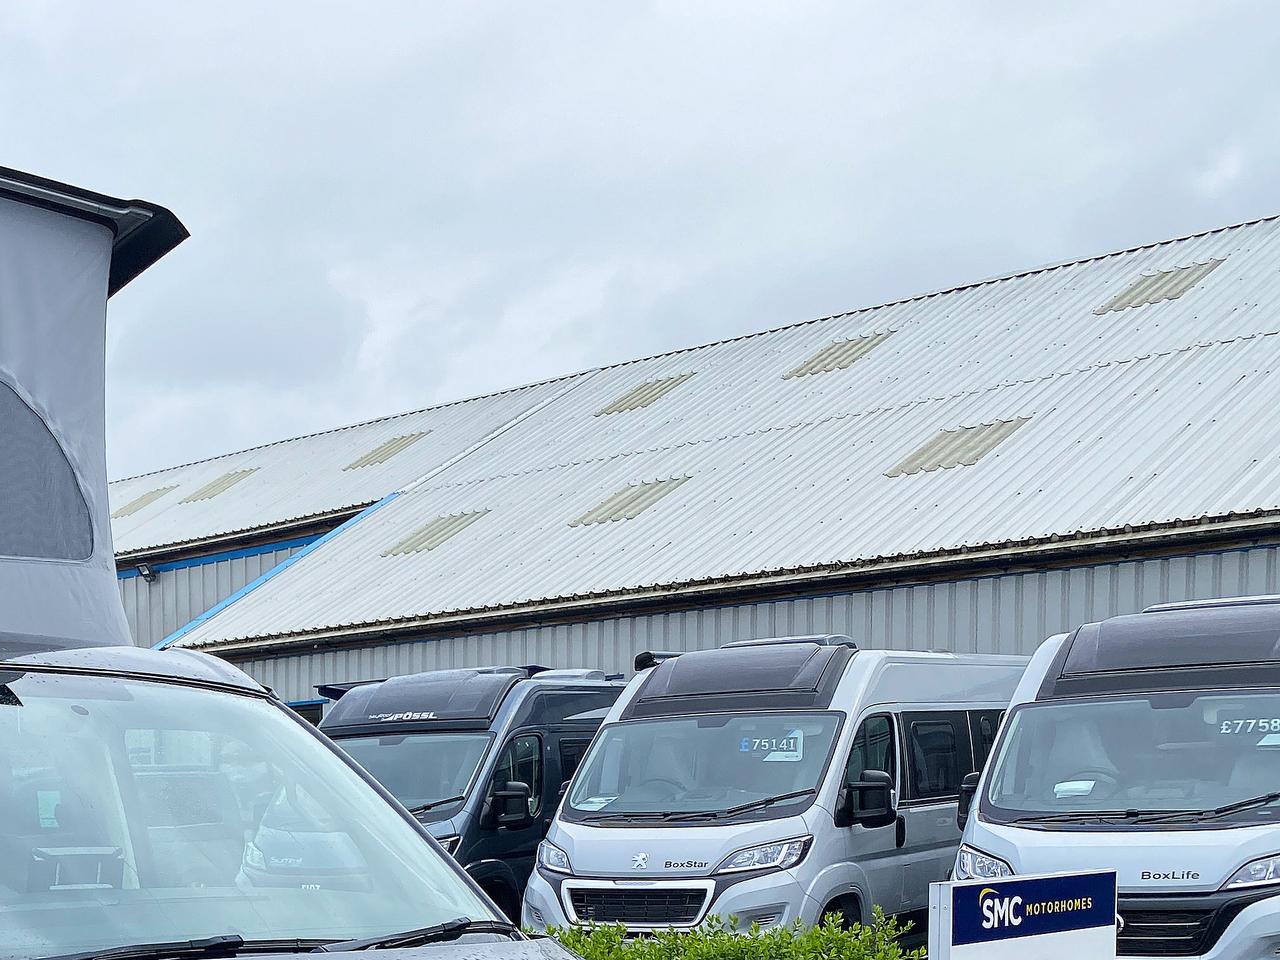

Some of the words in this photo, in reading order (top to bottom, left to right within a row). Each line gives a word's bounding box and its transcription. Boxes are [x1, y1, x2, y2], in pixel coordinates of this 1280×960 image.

[664, 860, 709, 869] BoxStar
[1140, 870, 1200, 881] BoxLife
[981, 894, 1023, 929] SMC
[1026, 897, 1092, 915] MOTORHOMES
